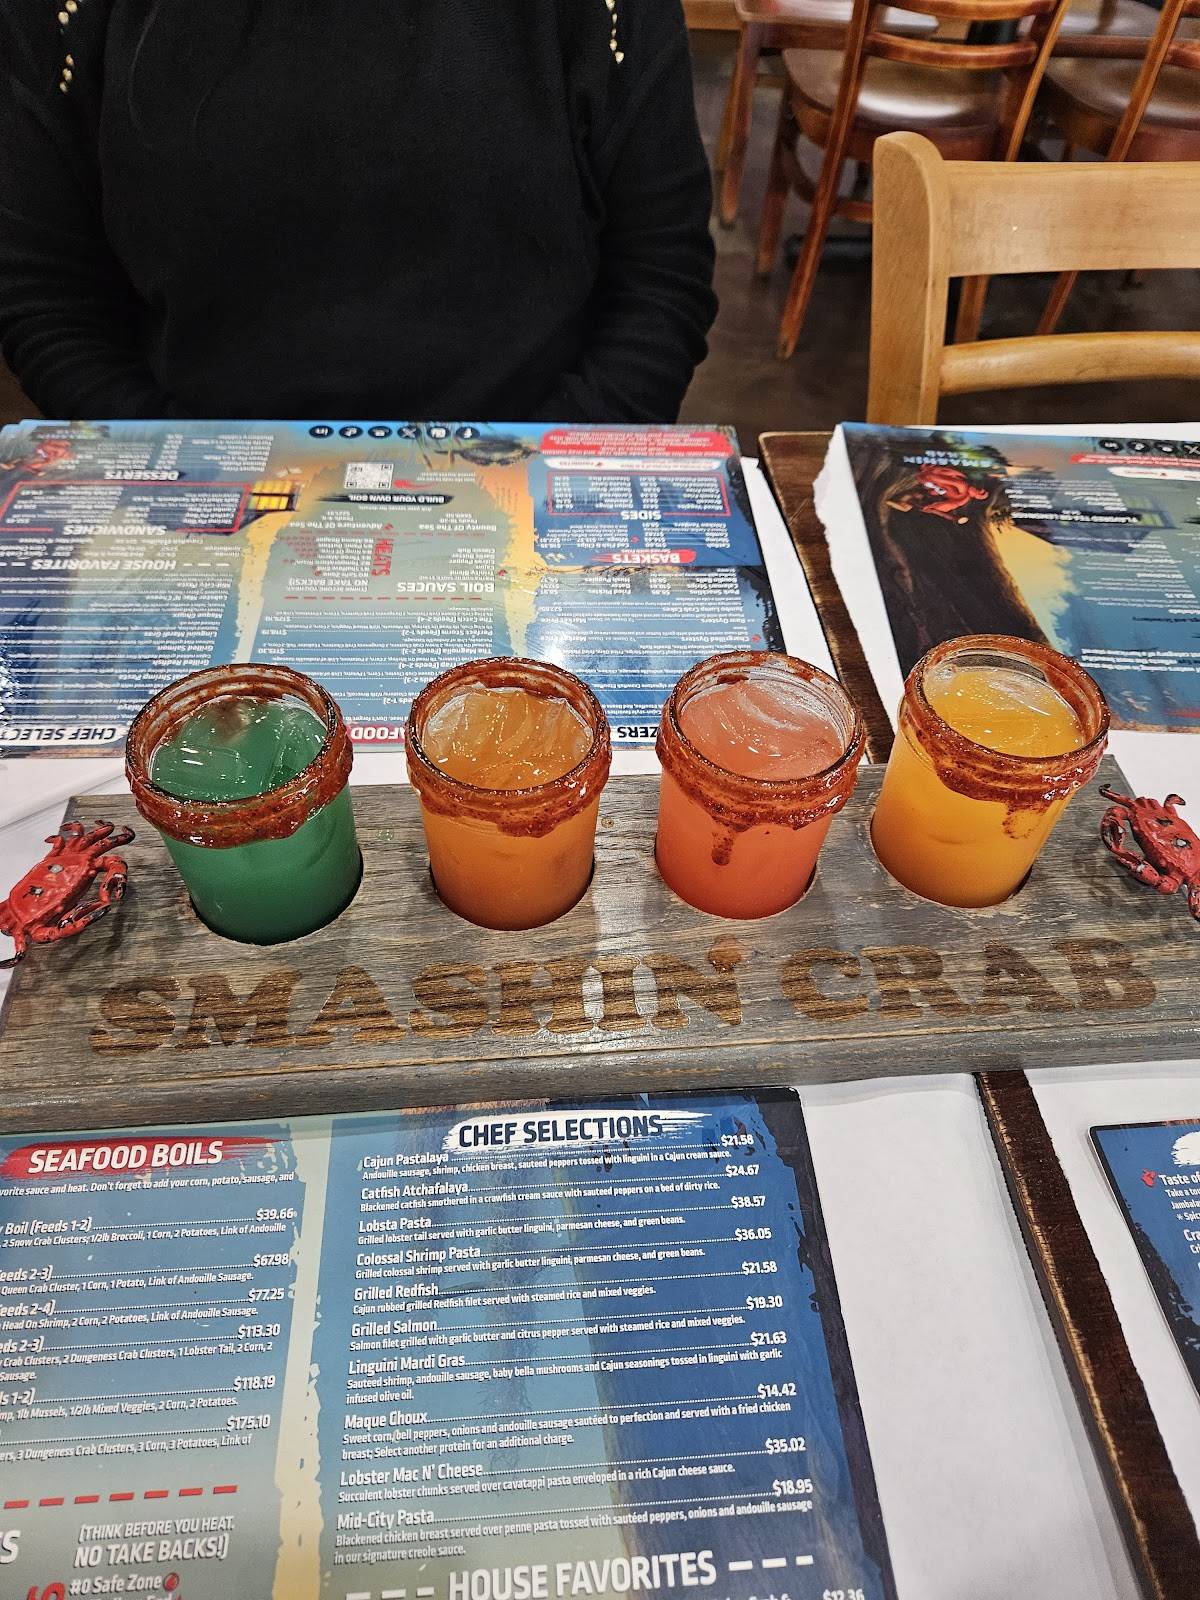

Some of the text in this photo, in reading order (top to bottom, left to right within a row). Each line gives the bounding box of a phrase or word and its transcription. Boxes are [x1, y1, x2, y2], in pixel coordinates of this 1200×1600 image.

[104, 470, 179, 480] DESSERTS
[620, 510, 662, 520] SIDES
[63, 524, 167, 535] SANDWICHES
[31, 559, 176, 570] HOUSE FAVORITES
[612, 553, 680, 564] BASKETS
[397, 582, 495, 592] BOIL SAUCES
[68, 728, 116, 740] CHEF
[350, 727, 405, 739] AFOOD
[780, 936, 1157, 1022] CRAB
[458, 1115, 664, 1148] CHEF SELECTIONS
[27, 1140, 223, 1175] SEAFOOD BOILS
[363, 1134, 754, 1170] Cajun Pastalaya $21.58
[361, 1164, 759, 1201] Catfish Atchafalaya $24.67
[1158, 1174, 1190, 1186] Taste
[1165, 1189, 1183, 1198] Take
[5, 1207, 294, 1236] Boil (Feeds 1-2) $39.66
[359, 1195, 766, 1234] Lobsta Pasta $38.57
[2, 1237, 9, 1248] 2
[9, 1237, 33, 1248] Snow
[34, 1235, 52, 1247] Crab
[110, 1229, 145, 1243] Broccoli,
[147, 1230, 151, 1240] 1
[152, 1228, 174, 1241] Corn,
[174, 1228, 180, 1239] 2
[181, 1226, 220, 1239] Potatoes,
[220, 1225, 238, 1236] Link
[239, 1224, 249, 1235] of
[249, 1222, 287, 1234] Andouille
[356, 1228, 772, 1267] Colossal Shrimp Pasta $36.05
[29, 1265, 53, 1282] 2-3)
[354, 1261, 778, 1302] Grilled Redfish $21.58
[29, 1300, 56, 1316] 2-4)
[248, 1288, 284, 1304] $77.25
[352, 1285, 657, 1316] Cajun rubbed grilled Redfish filet served with steamed rice and mixed veggies.
[351, 1296, 783, 1338] Grilled Salmon $19.30
[236, 1323, 281, 1341] $113.30
[348, 1331, 787, 1377] Linguini Mardi Gras $21.63
[233, 1374, 276, 1393] $118.19
[345, 1389, 415, 1405] infused olive oil.
[344, 1383, 797, 1431] Maque Choux $14.42
[226, 1414, 271, 1431] $175.10
[339, 1469, 390, 1487] Lobster
[393, 1467, 419, 1482] Mac
[437, 1463, 483, 1479] Cheese
[765, 1437, 806, 1455] $35.02
[336, 1478, 813, 1531] Mid-City Pasta $18.95
[79, 1515, 235, 1544] (THINK BEFORE YOU HEAT.
[73, 1533, 230, 1569] NO TAKE BACKS!)
[70, 1578, 92, 1596] #0
[93, 1574, 125, 1595] Safe
[127, 1573, 162, 1592] Zone
[449, 1550, 718, 1600] HOUSE FAVORITES
